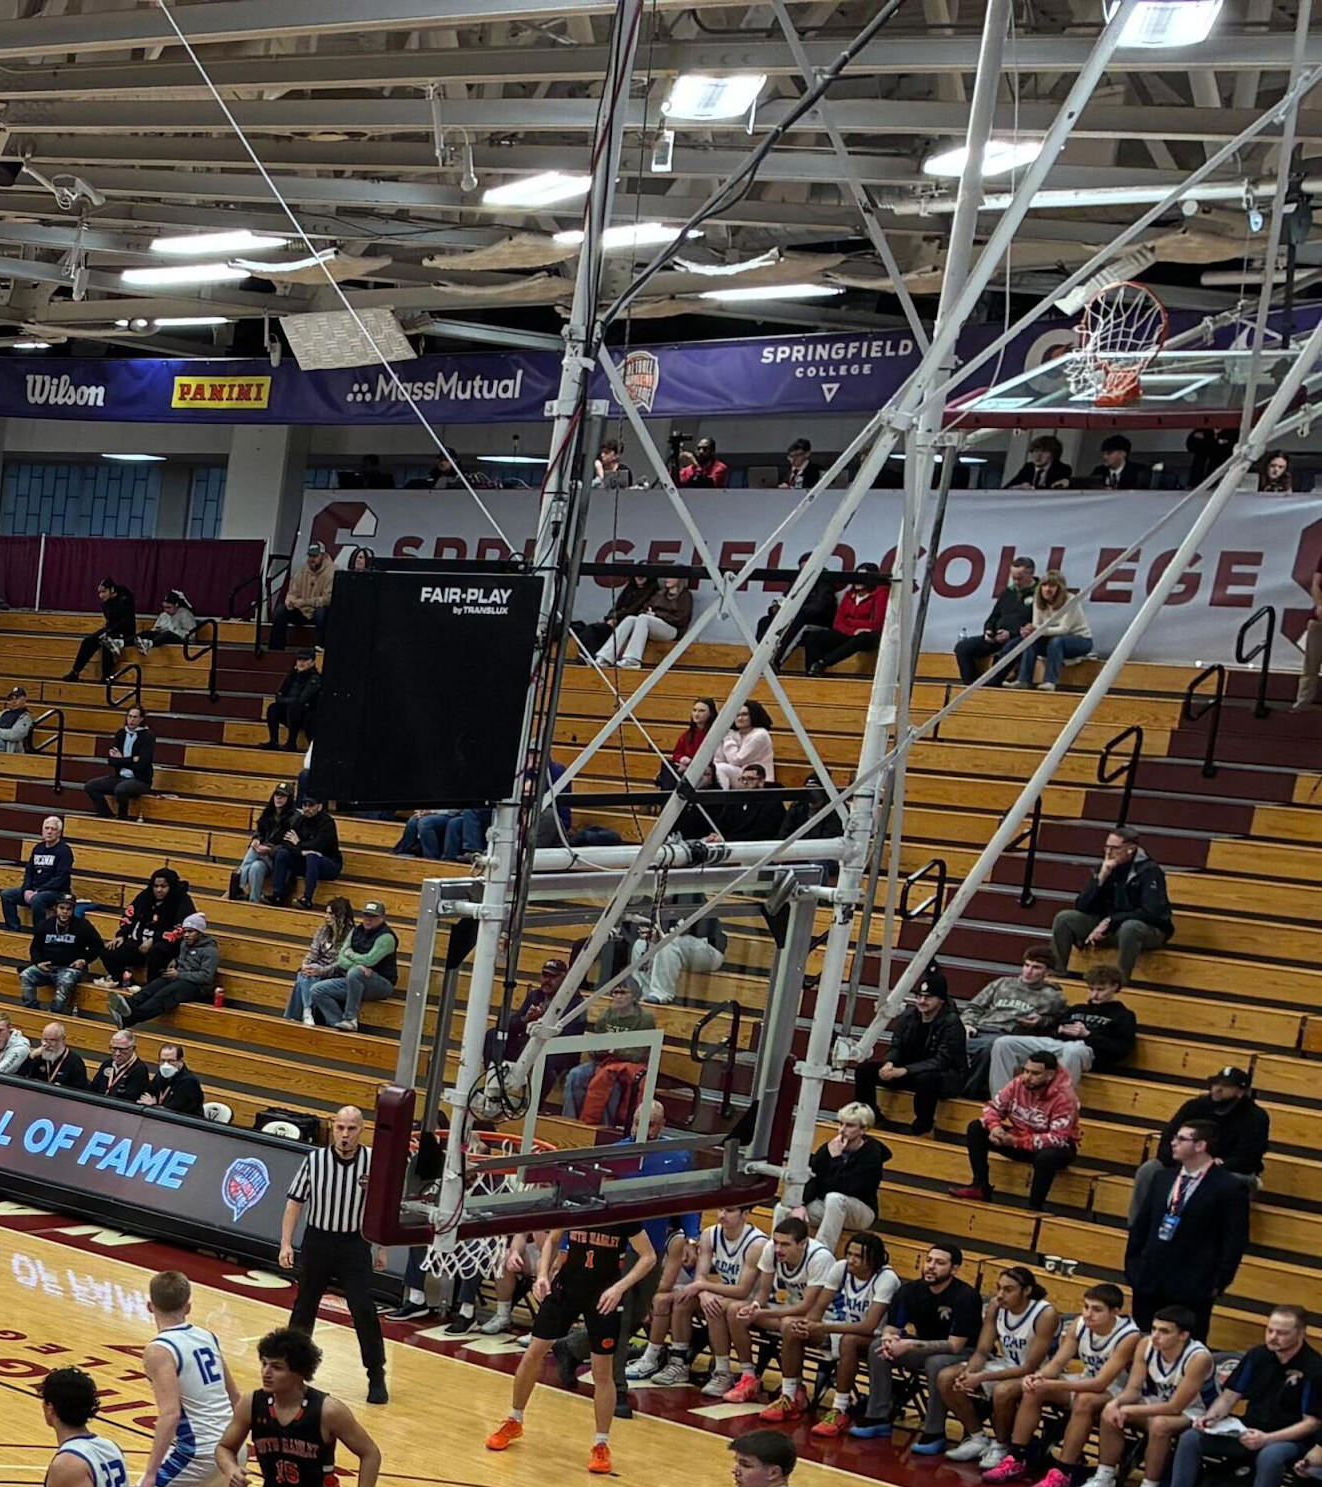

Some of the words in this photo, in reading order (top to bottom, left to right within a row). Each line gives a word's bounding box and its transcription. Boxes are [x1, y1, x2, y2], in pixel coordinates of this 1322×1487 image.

[761, 339, 914, 365] SPRINGFIELD
[795, 363, 873, 378] COLLEGE
[25, 374, 105, 408] Wilson
[177, 382, 265, 401] PANINI
[375, 368, 524, 402] MassMutual
[453, 606, 462, 615] by
[463, 605, 509, 615] TRANSLUX
[23, 1118, 84, 1158] OF
[77, 1130, 199, 1189] FAME
[192, 1346, 222, 1387] 12
[275, 1459, 300, 1485] 15
